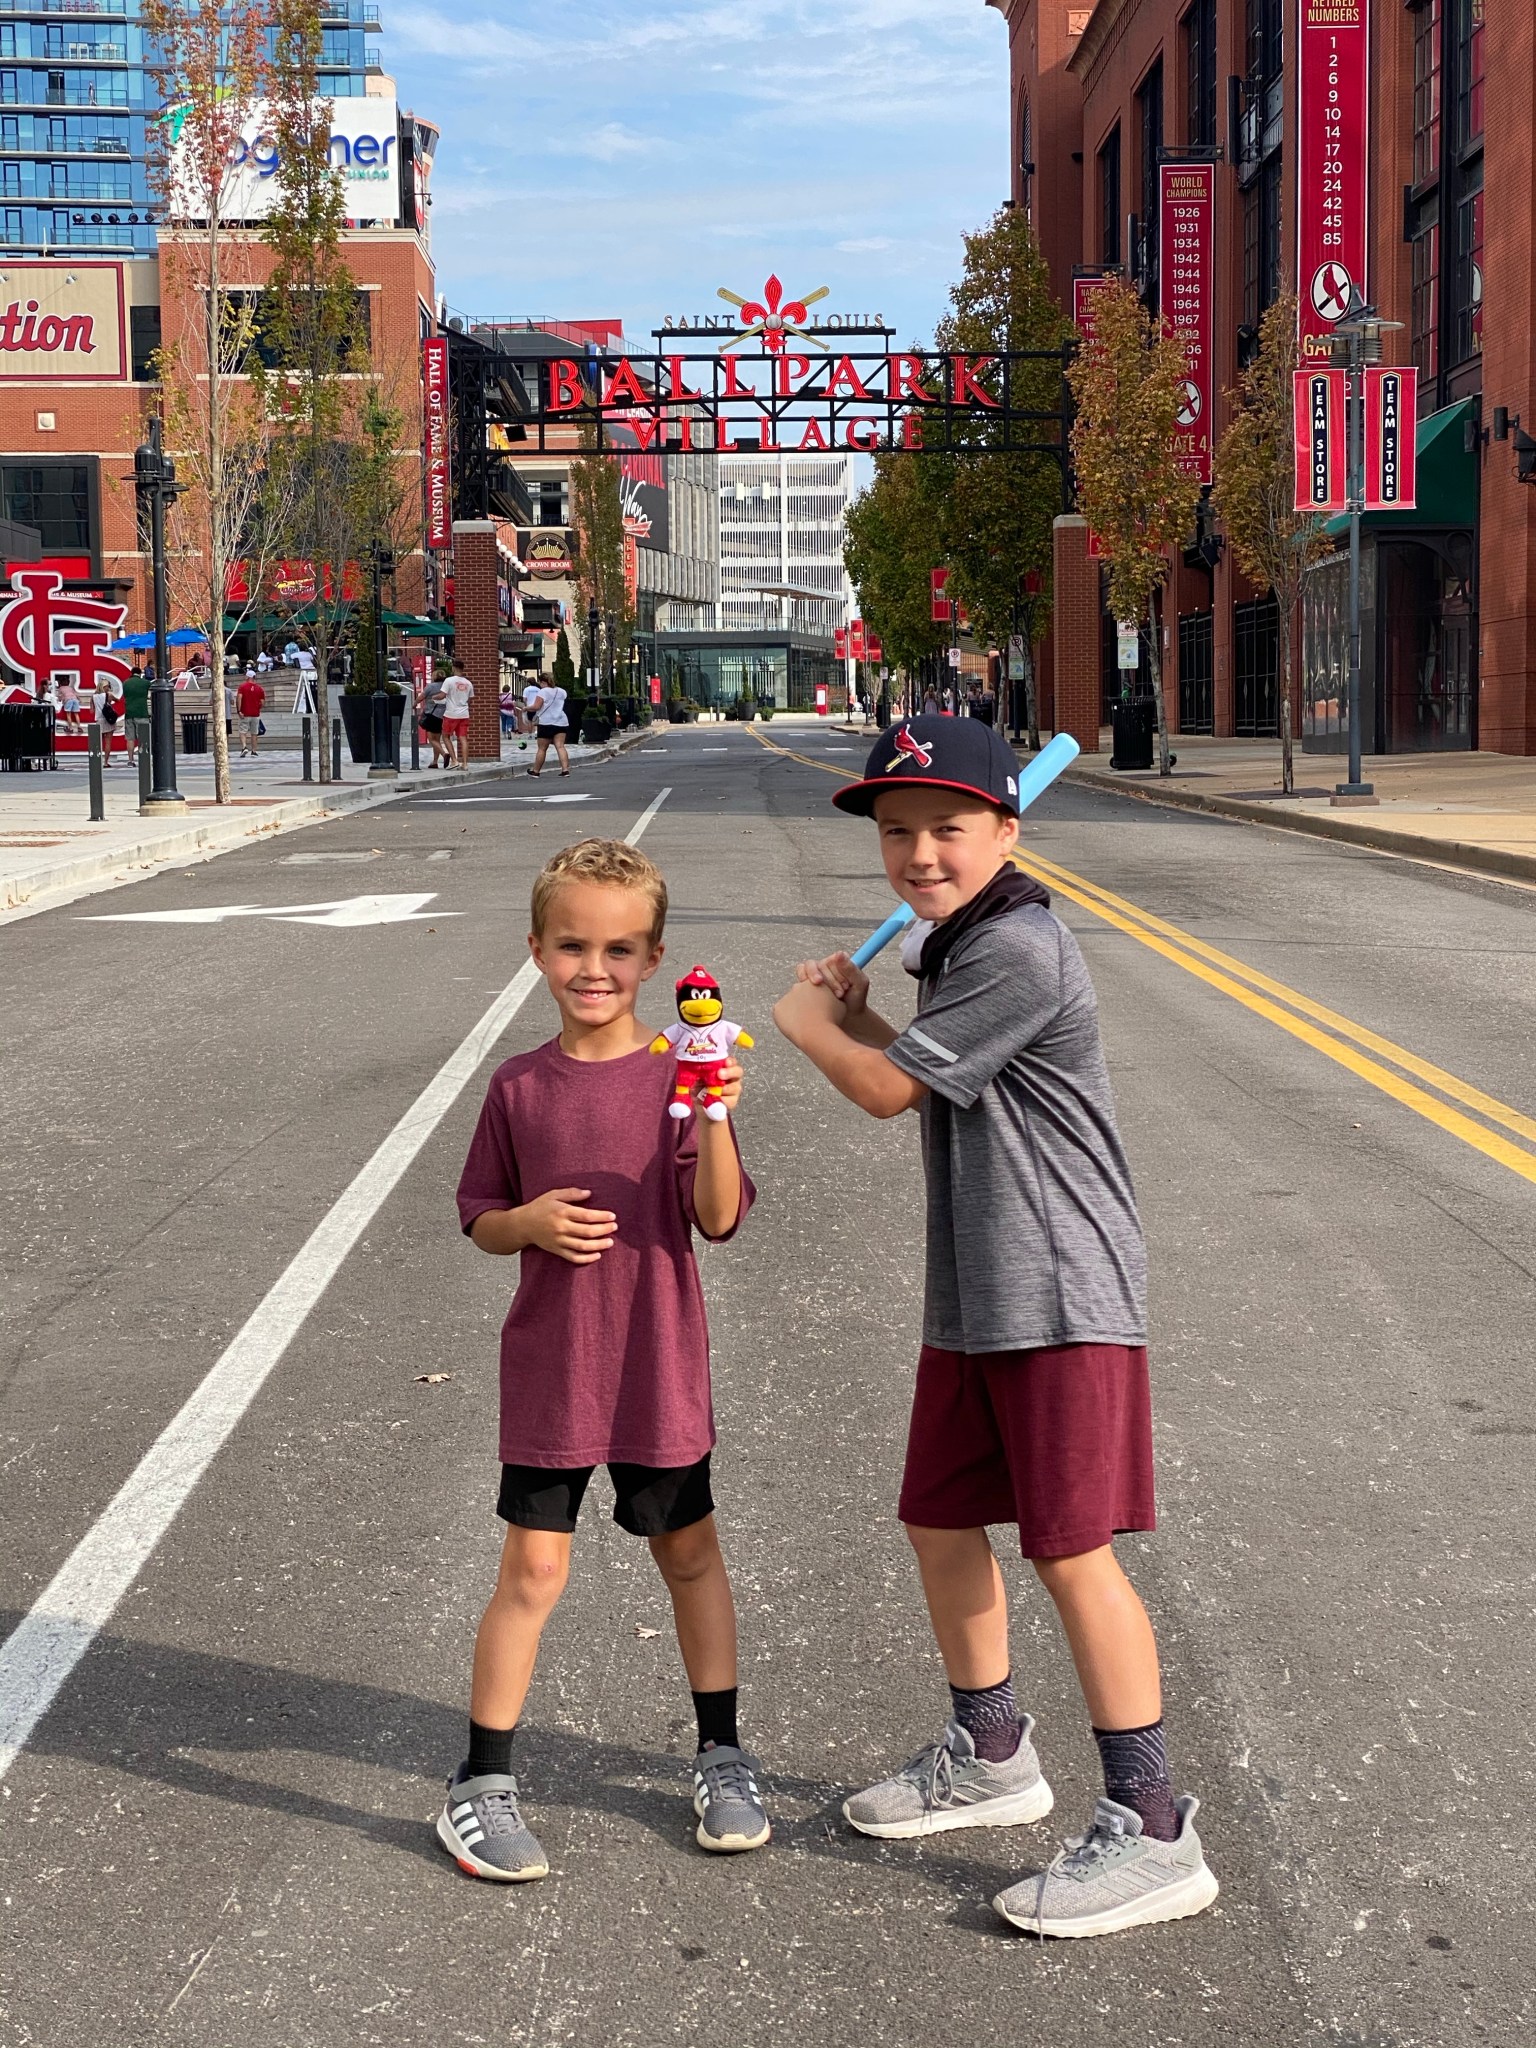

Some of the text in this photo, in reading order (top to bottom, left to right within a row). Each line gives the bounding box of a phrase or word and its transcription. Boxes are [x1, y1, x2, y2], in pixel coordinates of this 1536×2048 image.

[1308, 8, 1359, 22] NUMBERS
[1330, 36, 1336, 49] 1
[1329, 54, 1338, 67] 2
[1328, 72, 1338, 85] 6
[1328, 90, 1338, 103] 9
[1324, 108, 1341, 121] 10
[1324, 126, 1341, 138] 14
[1325, 144, 1341, 156] 17
[1323, 161, 1343, 174] 20
[1171, 176, 1203, 188] WORLD
[1323, 179, 1342, 191] 24
[1166, 188, 1207, 198] CHAMPIONS
[1323, 197, 1342, 209] 42
[1173, 207, 1200, 217] 1926
[1323, 215, 1342, 227] 45
[1174, 223, 1199, 233] 1931
[1173, 238, 1200, 248] 1934
[1323, 232, 1342, 245] 85
[1173, 253, 1200, 263] 1942
[1172, 269, 1200, 279] 1944
[1172, 284, 1200, 294] 1946
[1172, 300, 1200, 309] 1964
[664, 313, 883, 330] SAINT LOUIS
[1172, 315, 1200, 324] 1967
[546, 355, 1004, 411] BALLPARK
[627, 415, 924, 452] VILLAGE
[1384, 380, 1396, 498] TEAM STORE
[428, 347, 445, 540] HALL OF FAME & MUSEUM
[1199, 434, 1207, 452] 4
[1314, 382, 1326, 499] TEAM STORE
[1175, 461, 1200, 470] EFT
[625, 535, 633, 570] BREW
[67, 591, 93, 599] MUSEUM
